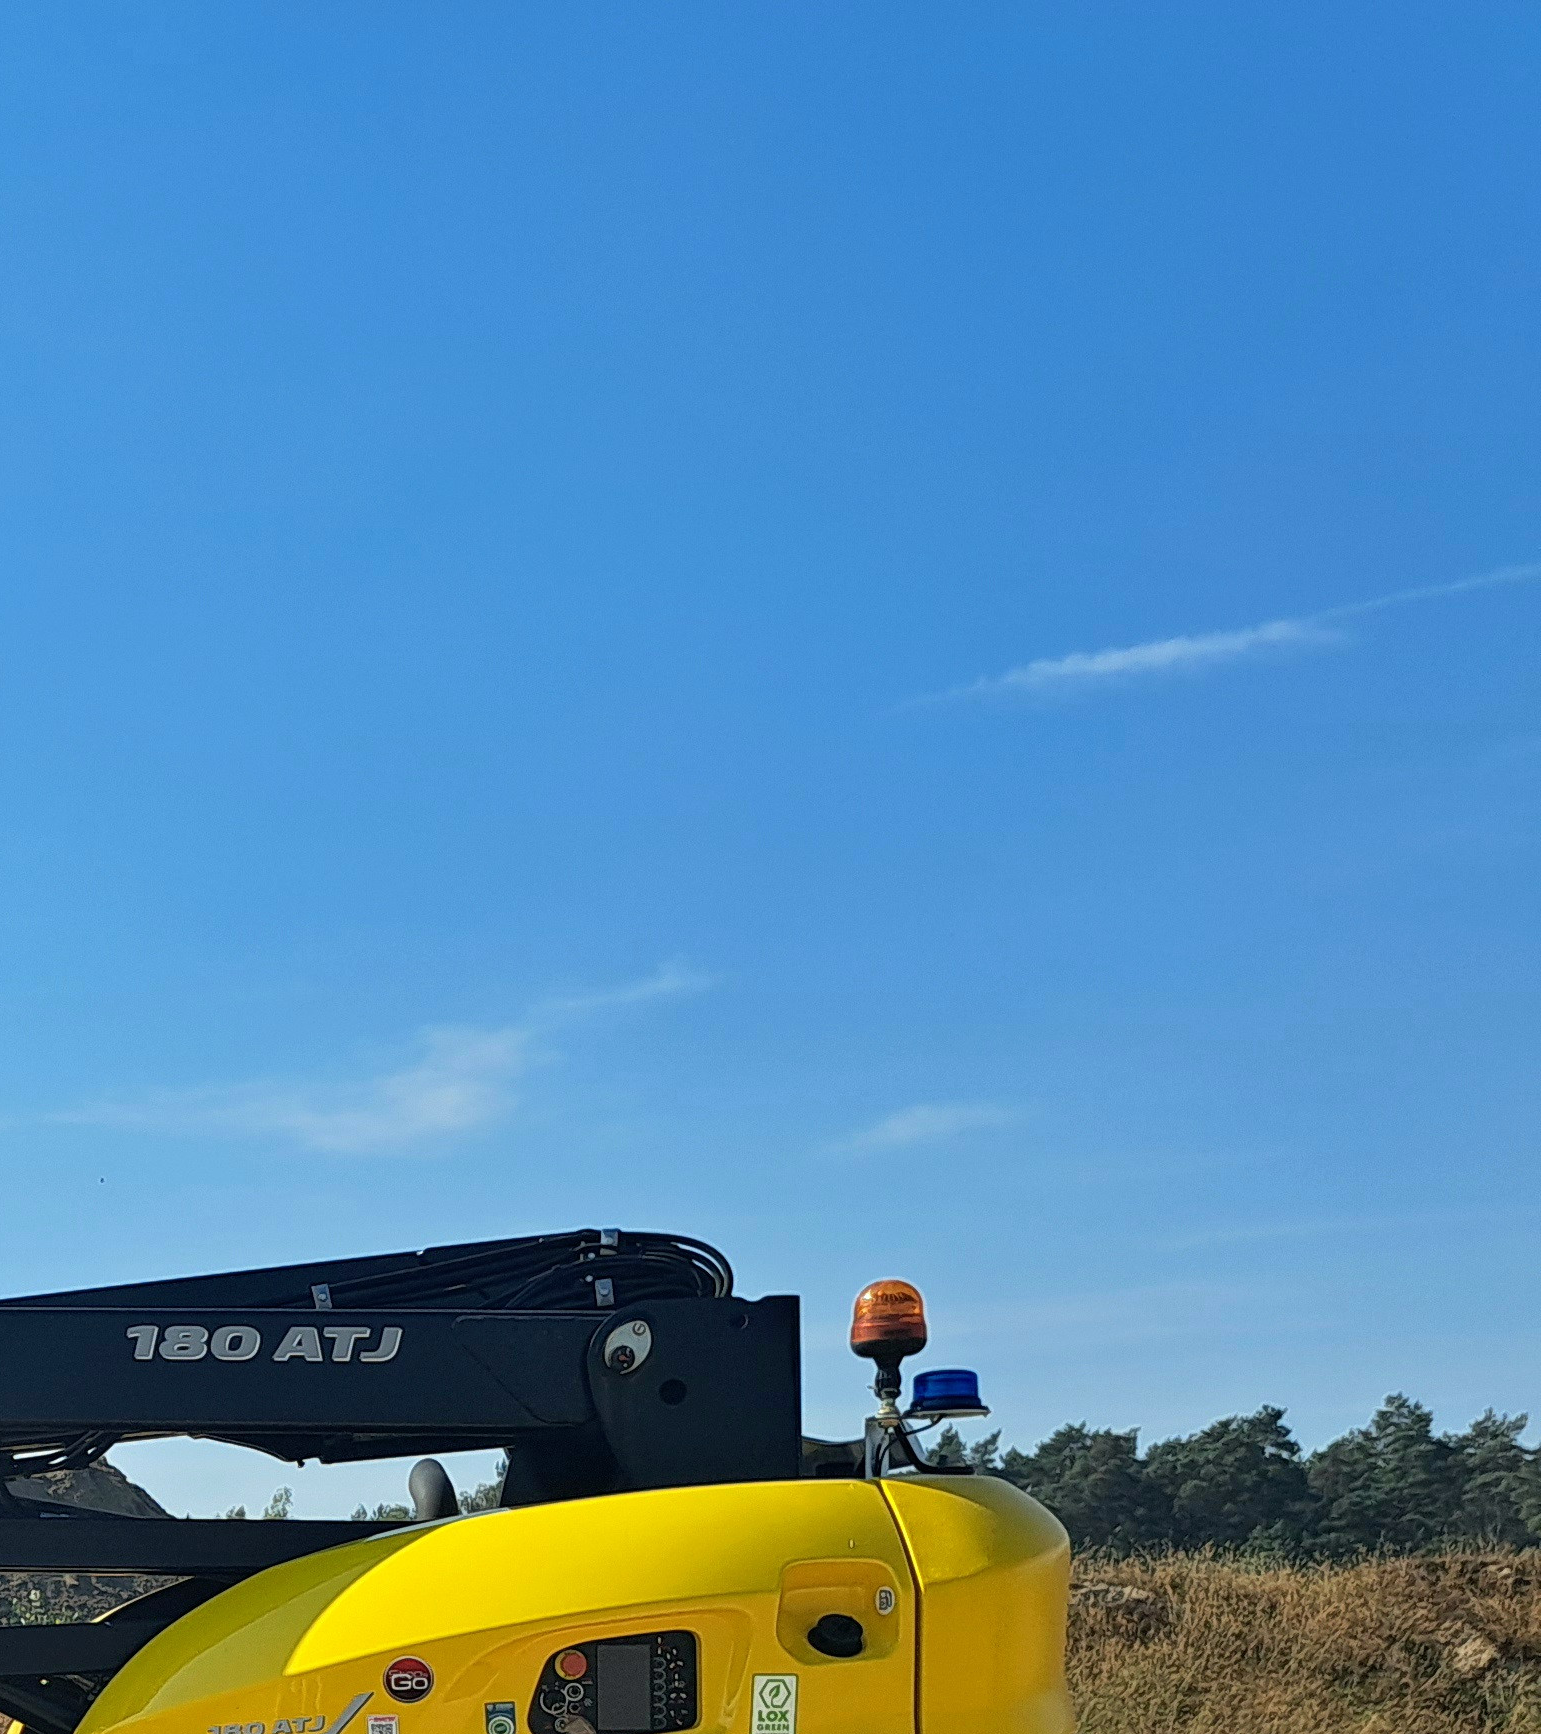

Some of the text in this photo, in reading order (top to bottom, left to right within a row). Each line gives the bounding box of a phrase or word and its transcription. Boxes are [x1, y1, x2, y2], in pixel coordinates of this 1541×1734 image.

[126, 1325, 404, 1363] 180 ATJ
[391, 1673, 428, 1690] Go
[757, 1710, 789, 1722] LOX
[756, 1723, 790, 1731] GREEN
